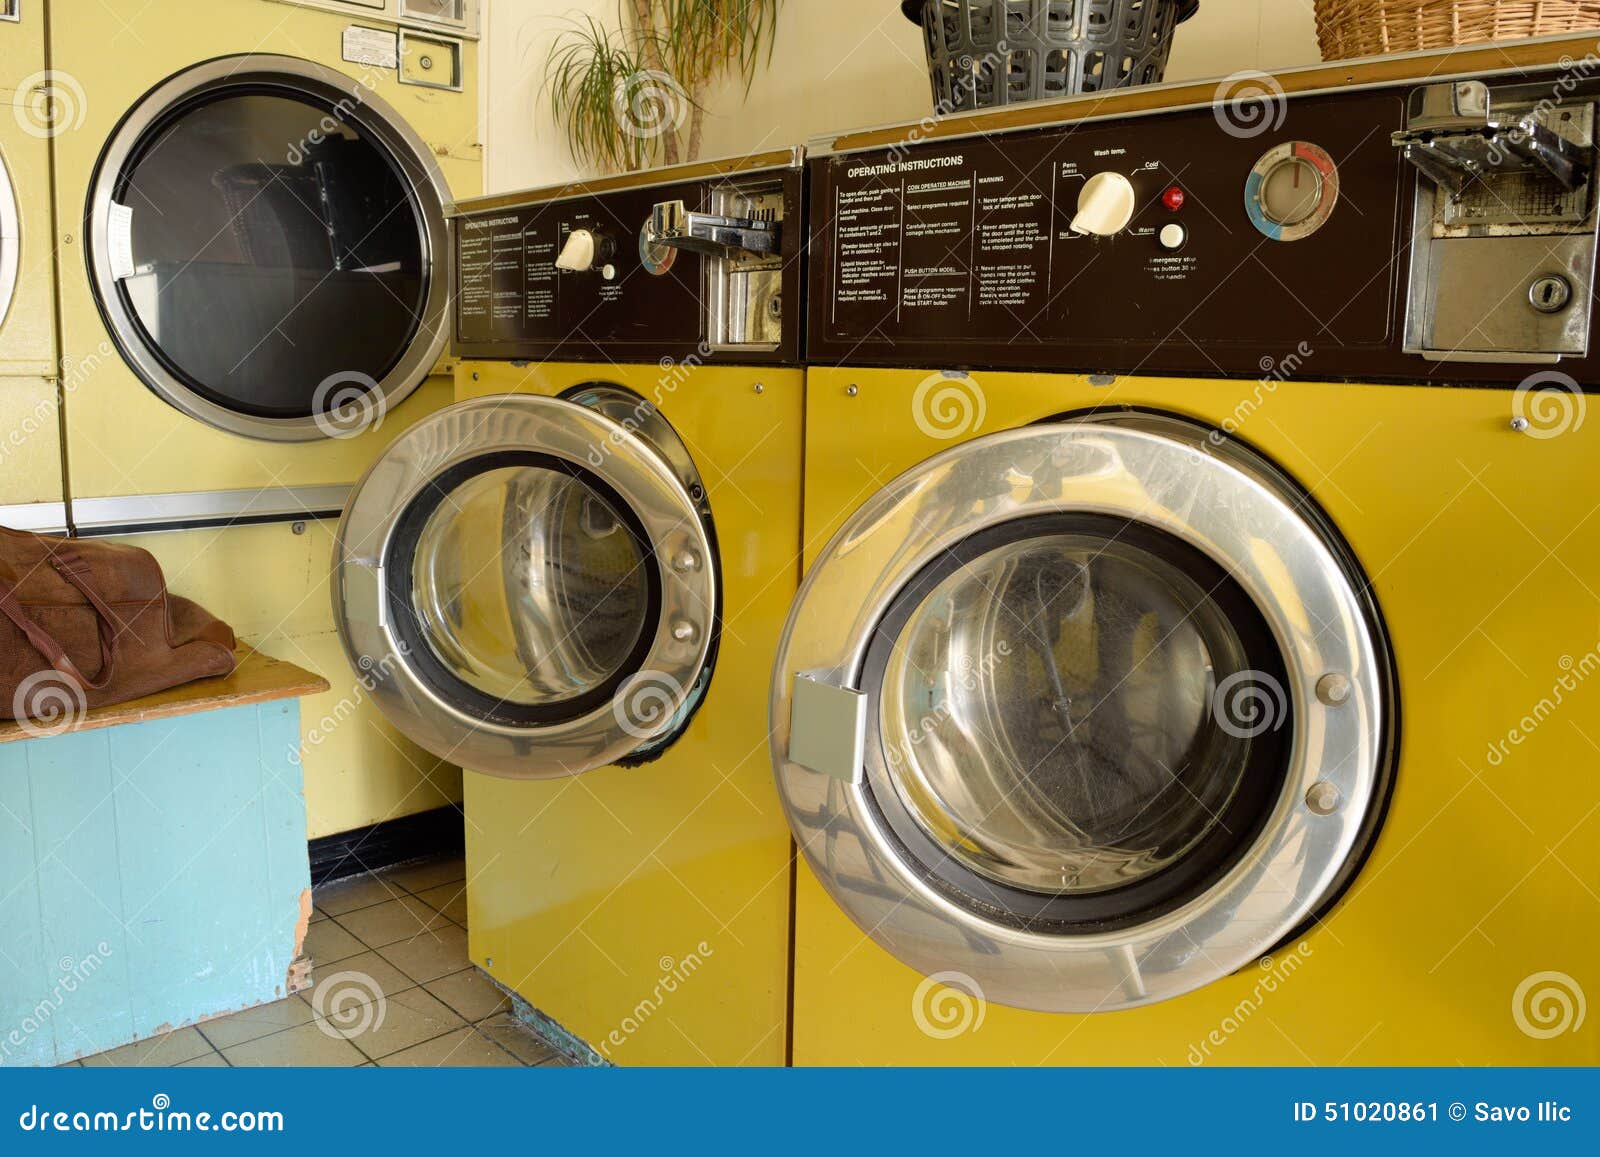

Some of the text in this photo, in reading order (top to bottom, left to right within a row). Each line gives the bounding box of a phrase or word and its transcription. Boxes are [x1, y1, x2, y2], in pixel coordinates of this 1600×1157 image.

[848, 155, 963, 178] OPERATING INSTRUCTIONS
[1145, 160, 1159, 168] Cold
[921, 182, 947, 190] OPERATED
[998, 223, 1018, 231] attempt
